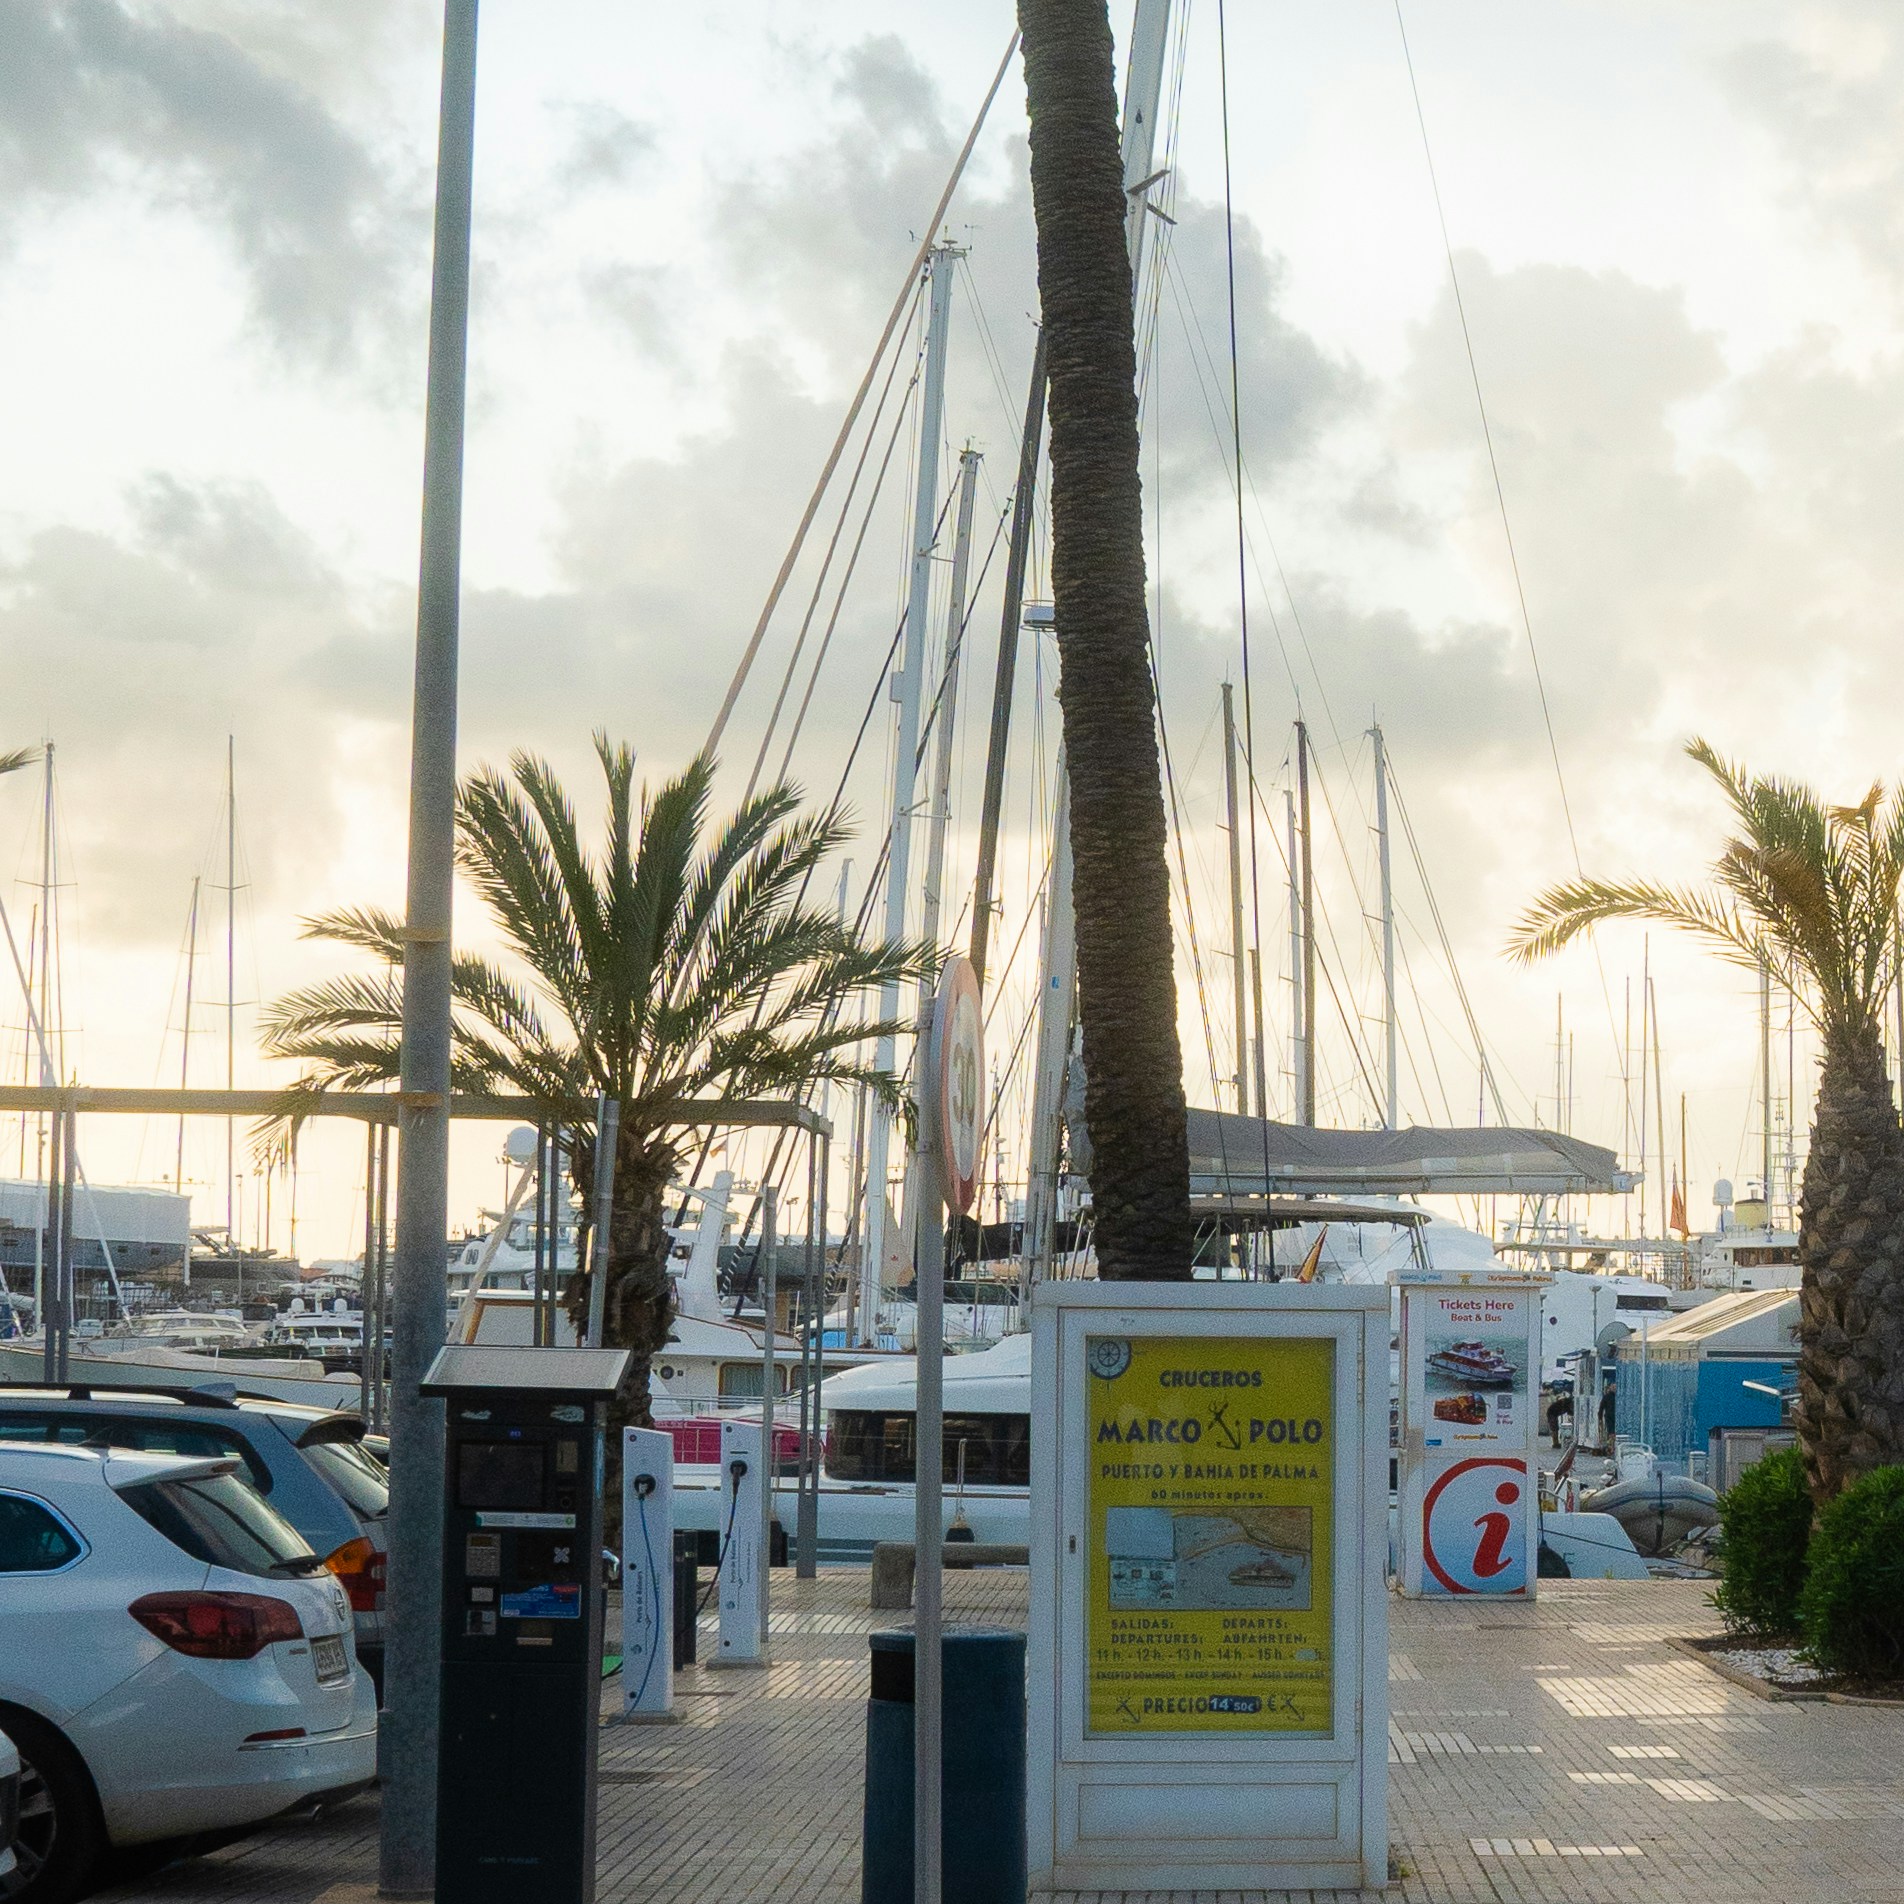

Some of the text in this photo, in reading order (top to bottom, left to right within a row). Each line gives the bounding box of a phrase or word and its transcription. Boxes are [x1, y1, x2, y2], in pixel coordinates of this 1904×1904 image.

[953, 1041, 976, 1128] 30
[1438, 1299, 1514, 1310] Tickets Here
[1451, 1313, 1502, 1322] Boat & Bus
[1159, 1370, 1263, 1388] CRUCEROS
[1097, 1419, 1323, 1444] MARCO POLO
[1101, 1463, 1319, 1480] PUERTO Y BAHIA DE PALMA
[1151, 1488, 1167, 1500] 60
[1170, 1489, 1222, 1500] minutos
[1111, 1619, 1174, 1629] SALIDAS:
[1111, 1634, 1203, 1645] DEPARTURES:
[1217, 1649, 1232, 1661] 14
[1258, 1649, 1272, 1661] 15
[1143, 1697, 1208, 1713] PRECIO
